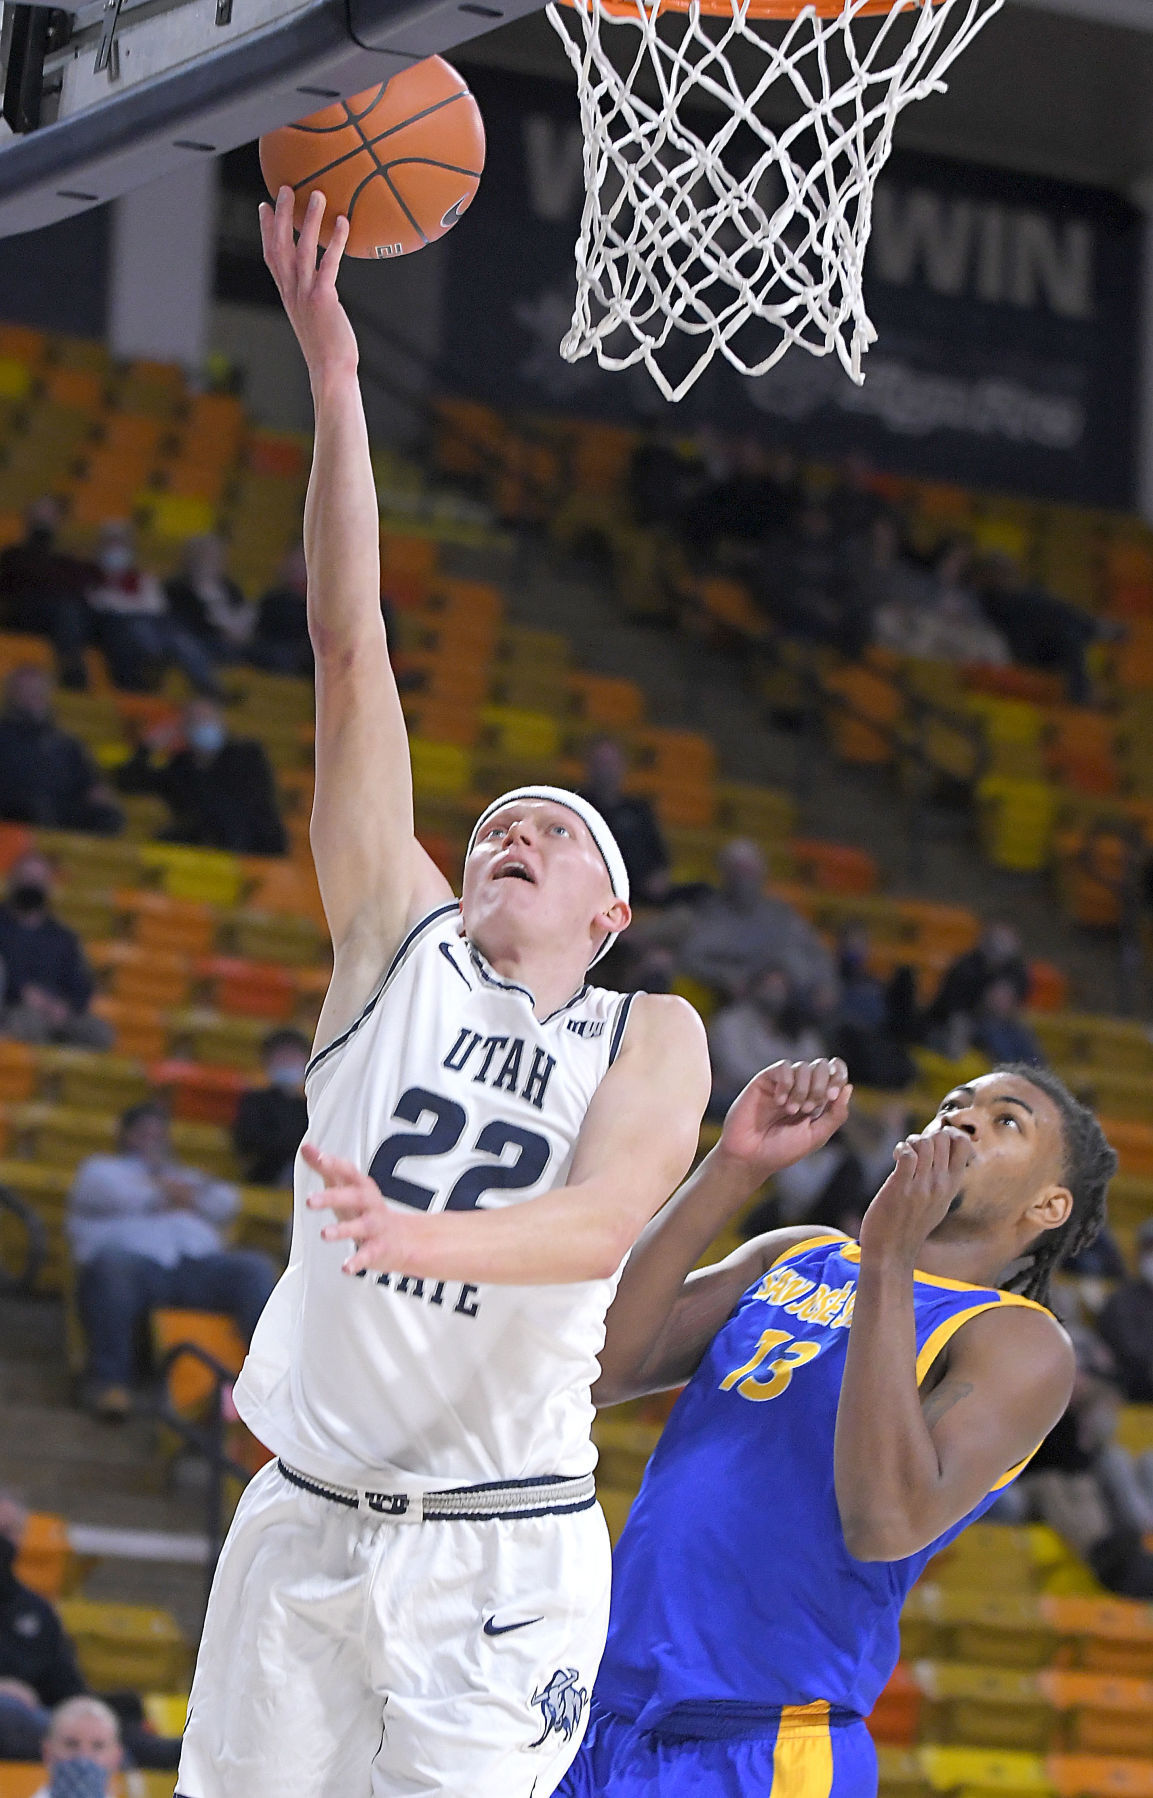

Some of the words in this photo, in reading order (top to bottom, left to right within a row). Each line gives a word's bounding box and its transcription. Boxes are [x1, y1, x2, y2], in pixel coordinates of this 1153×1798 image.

[872, 181, 1096, 319] WIN
[443, 1027, 557, 1110] UTAH
[368, 1087, 552, 1213] 22
[752, 1265, 817, 1306] SAN
[718, 1328, 822, 1402] 13
